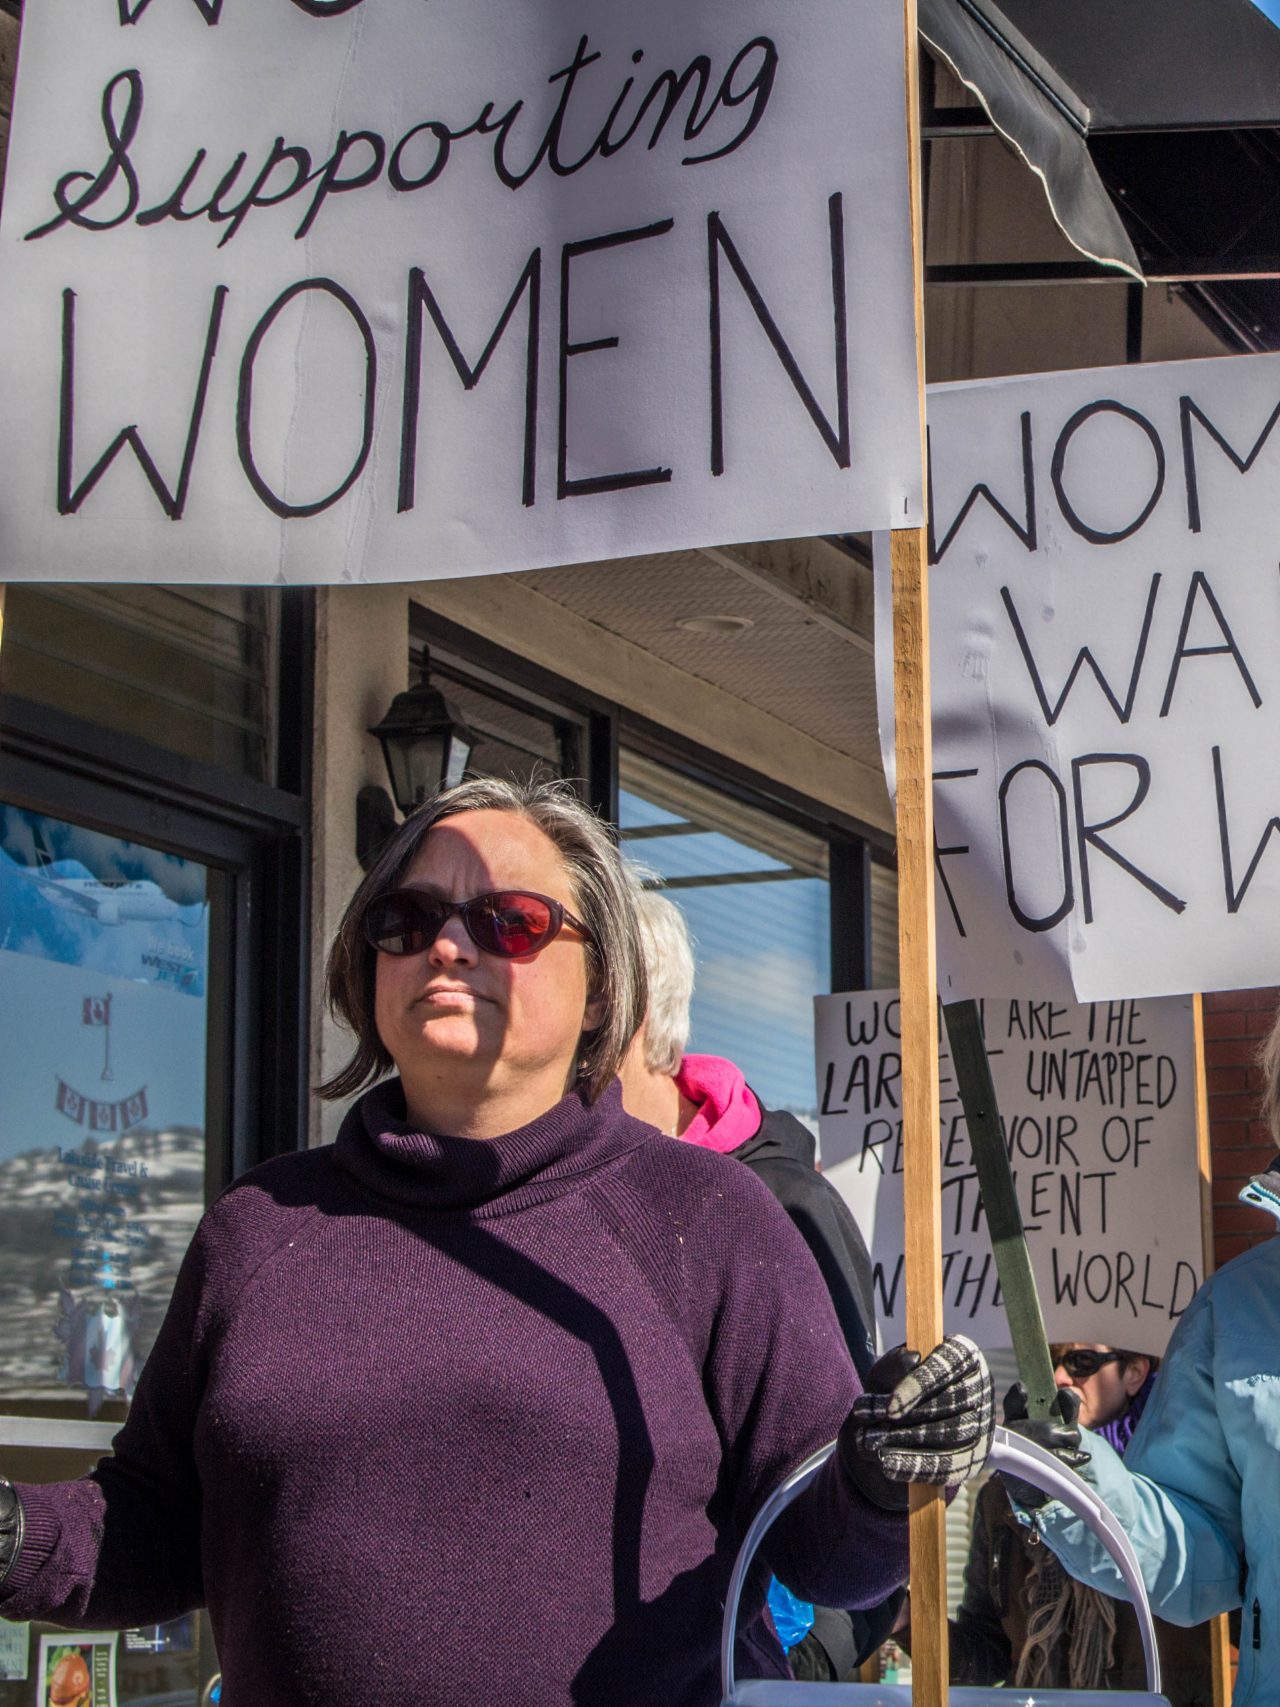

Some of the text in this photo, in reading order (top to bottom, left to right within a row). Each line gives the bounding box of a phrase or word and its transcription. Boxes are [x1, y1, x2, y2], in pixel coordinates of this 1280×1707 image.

[24, 34, 779, 248] Supporting
[57, 192, 851, 520] WOMEN
[1007, 999, 1071, 1041] ARE
[820, 1048, 1178, 1116] LARE UNTAPPED
[858, 1115, 1154, 1175] REEVOIR OF
[1052, 1248, 1198, 1320] WORLD
